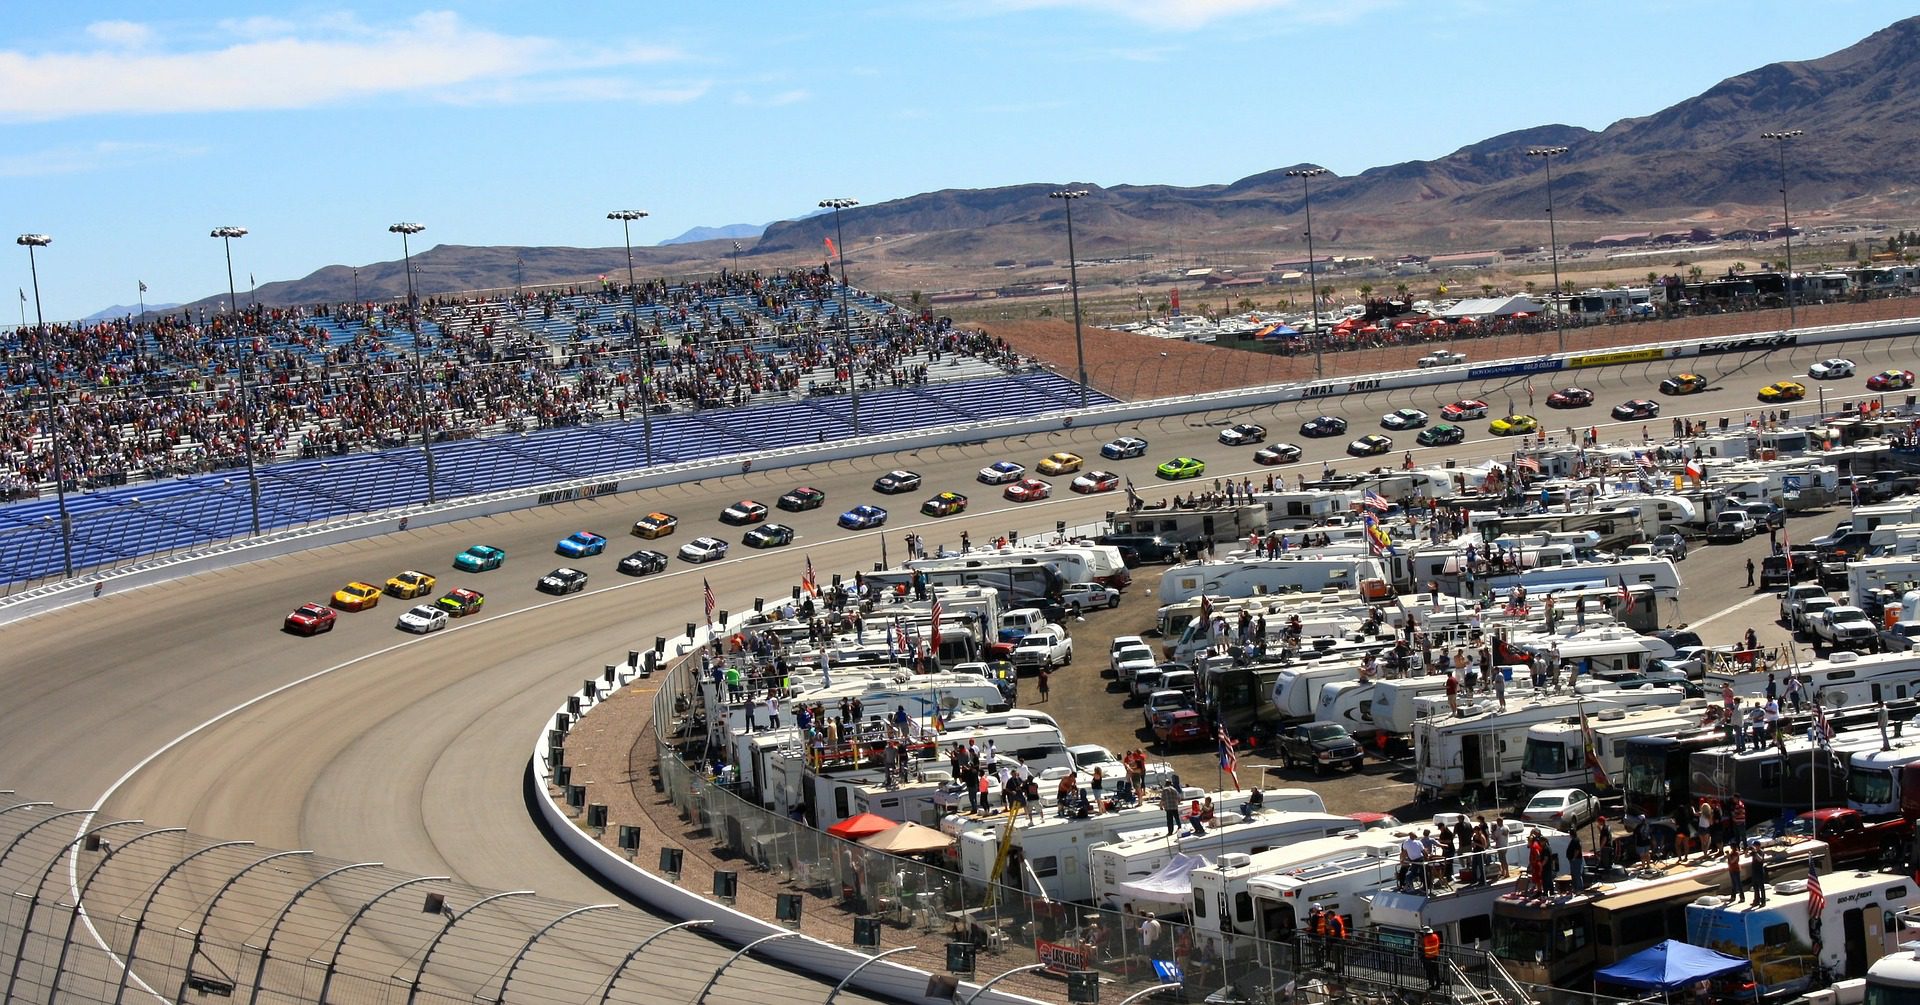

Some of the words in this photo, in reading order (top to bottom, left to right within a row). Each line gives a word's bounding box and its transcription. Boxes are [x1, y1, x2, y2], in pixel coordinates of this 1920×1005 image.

[1701, 341, 1745, 350] SRT
[1750, 335, 1791, 345] SRT
[1302, 385, 1334, 397] ZMAX
[1348, 379, 1381, 392] ZMAX
[1052, 947, 1063, 964] LAS
